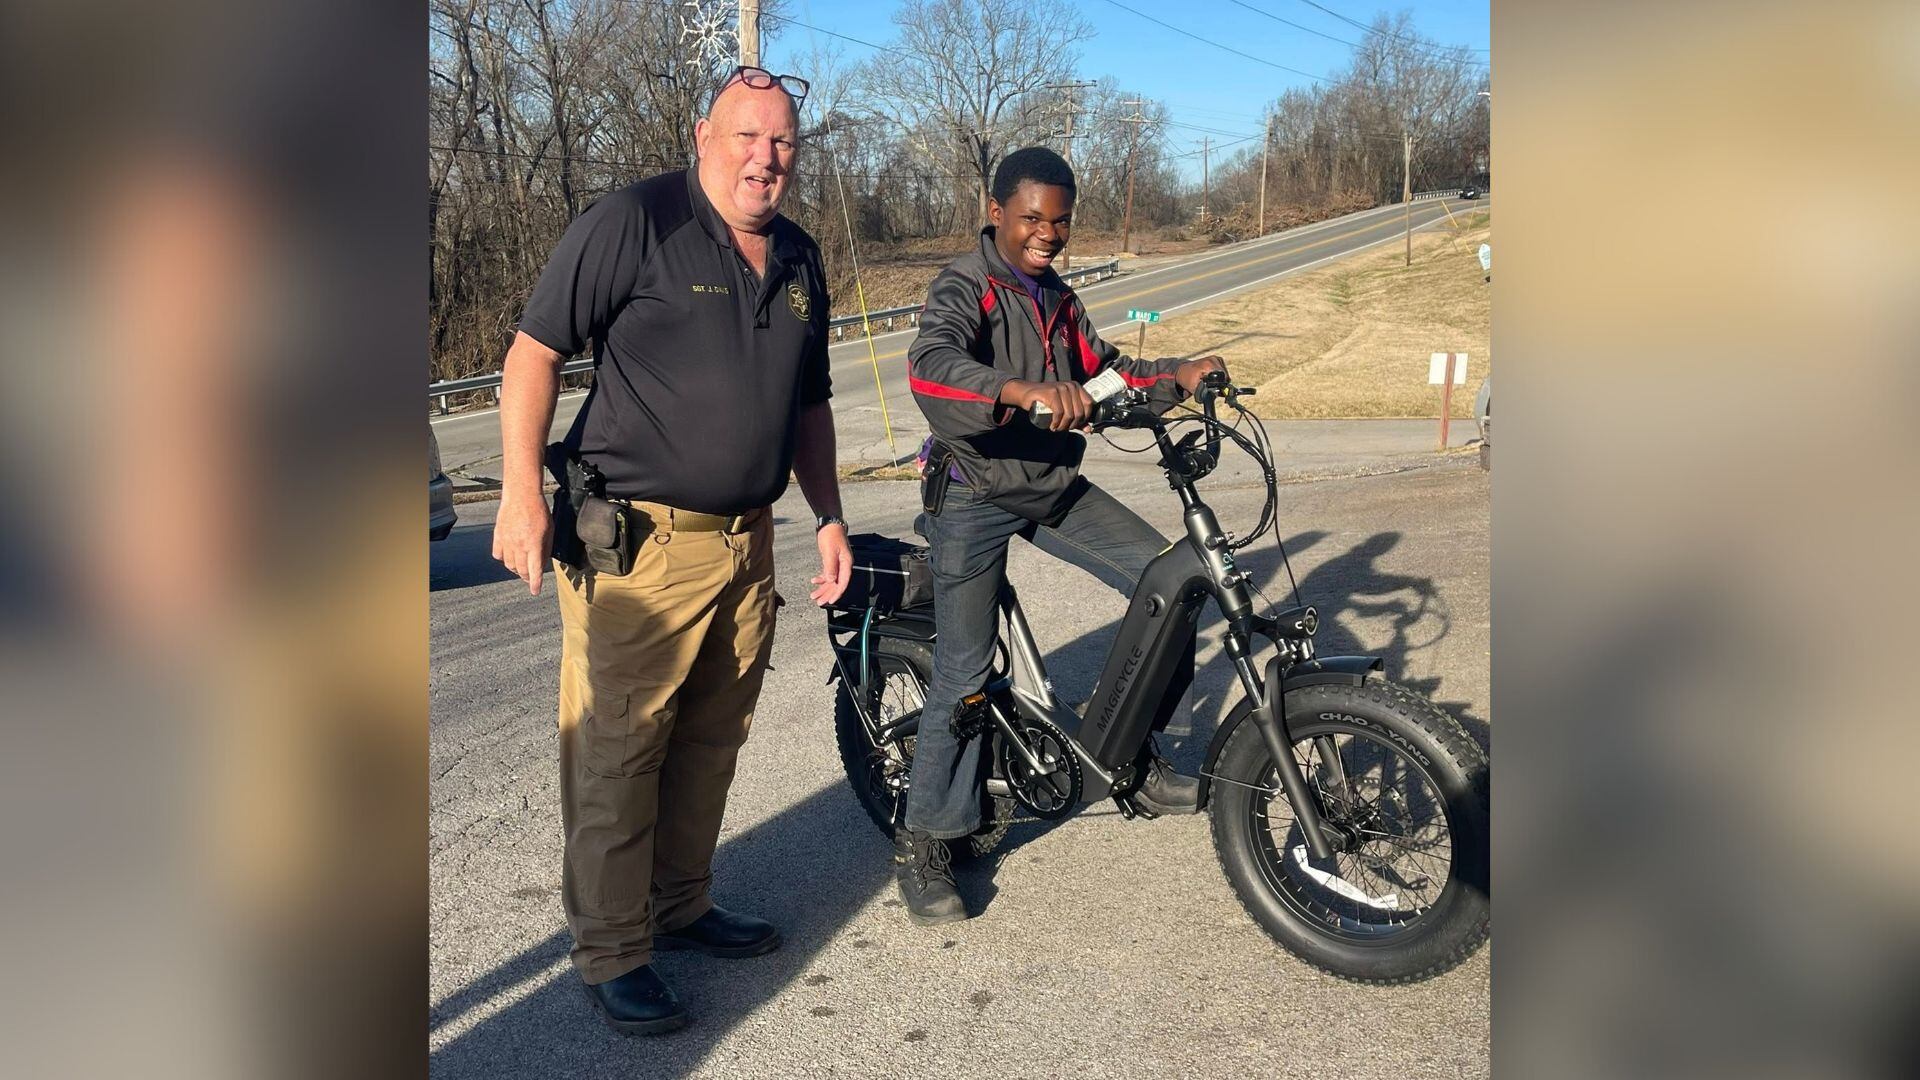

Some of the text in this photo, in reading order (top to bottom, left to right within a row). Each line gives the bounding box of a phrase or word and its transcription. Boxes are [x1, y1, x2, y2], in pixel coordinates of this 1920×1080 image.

[1096, 644, 1143, 733] MAGICYCLE
[1319, 712, 1431, 767] CHAO YANG
